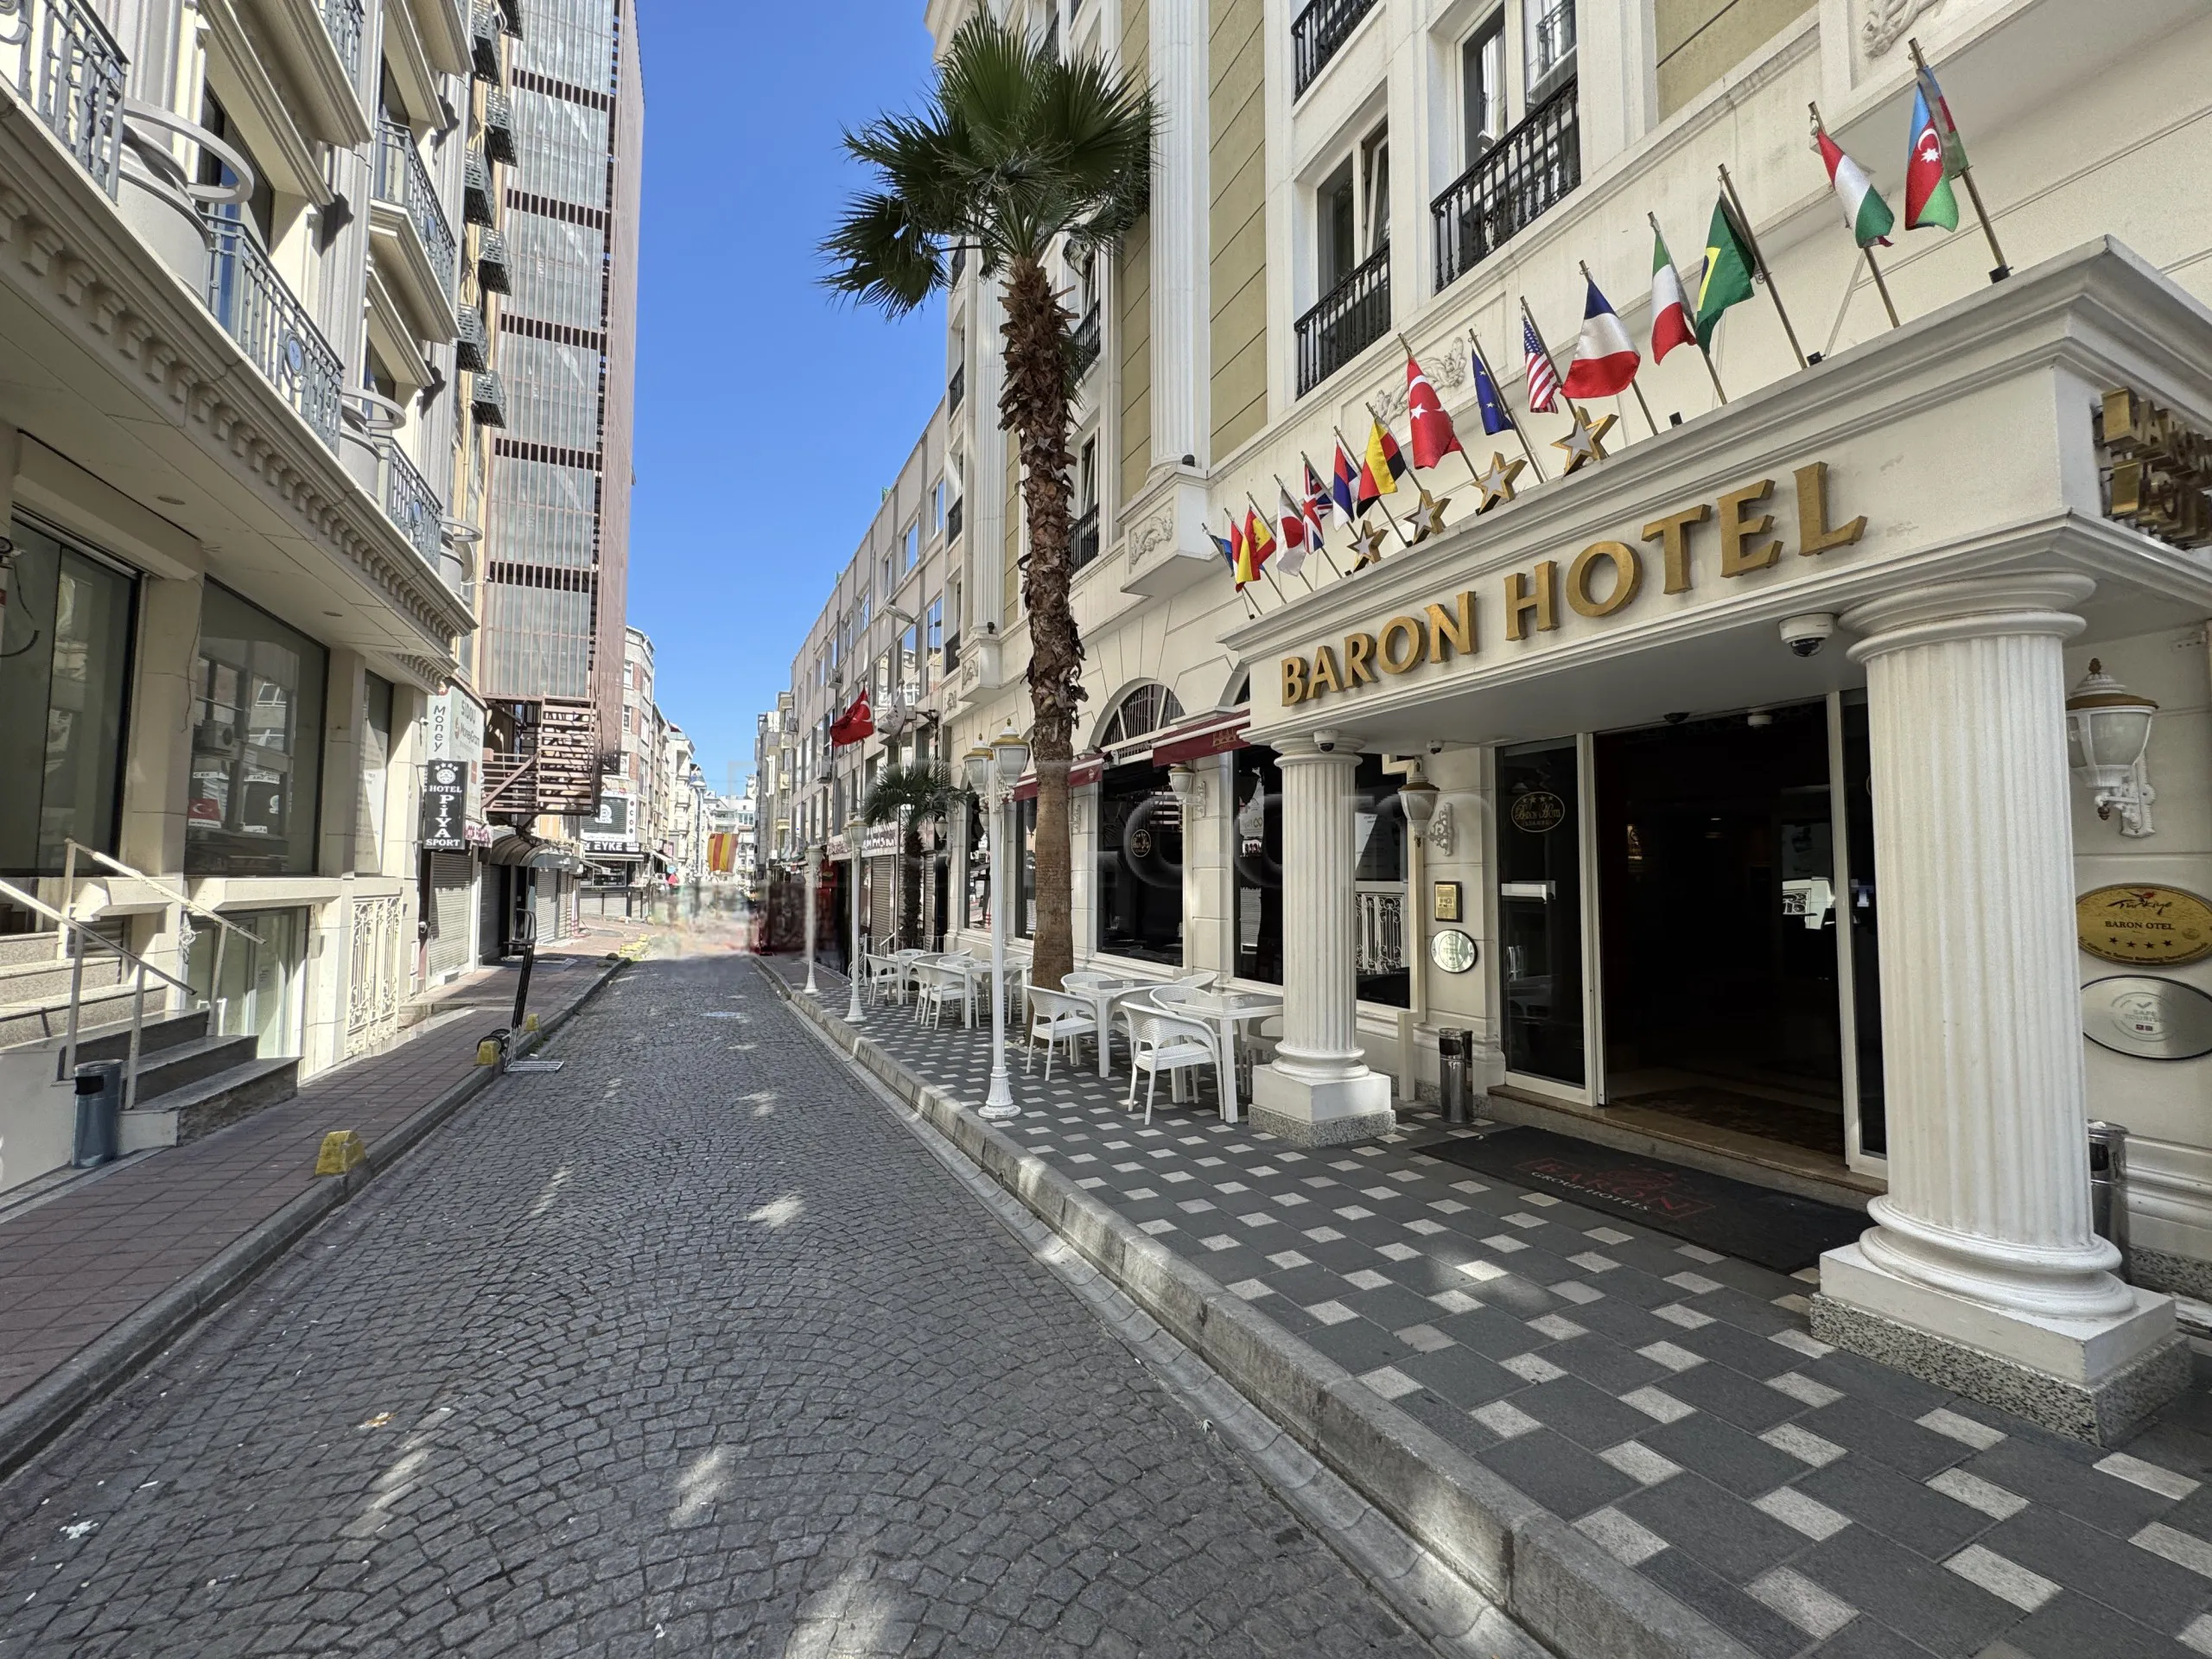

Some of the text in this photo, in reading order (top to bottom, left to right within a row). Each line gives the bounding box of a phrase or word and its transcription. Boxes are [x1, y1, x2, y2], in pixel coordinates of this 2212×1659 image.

[1281, 461, 1868, 708] BARON HOTEL
[433, 705, 446, 753] Money
[2145, 922, 2176, 931] OTEL
[1531, 1172, 1651, 1211] GROUP HOTELS
